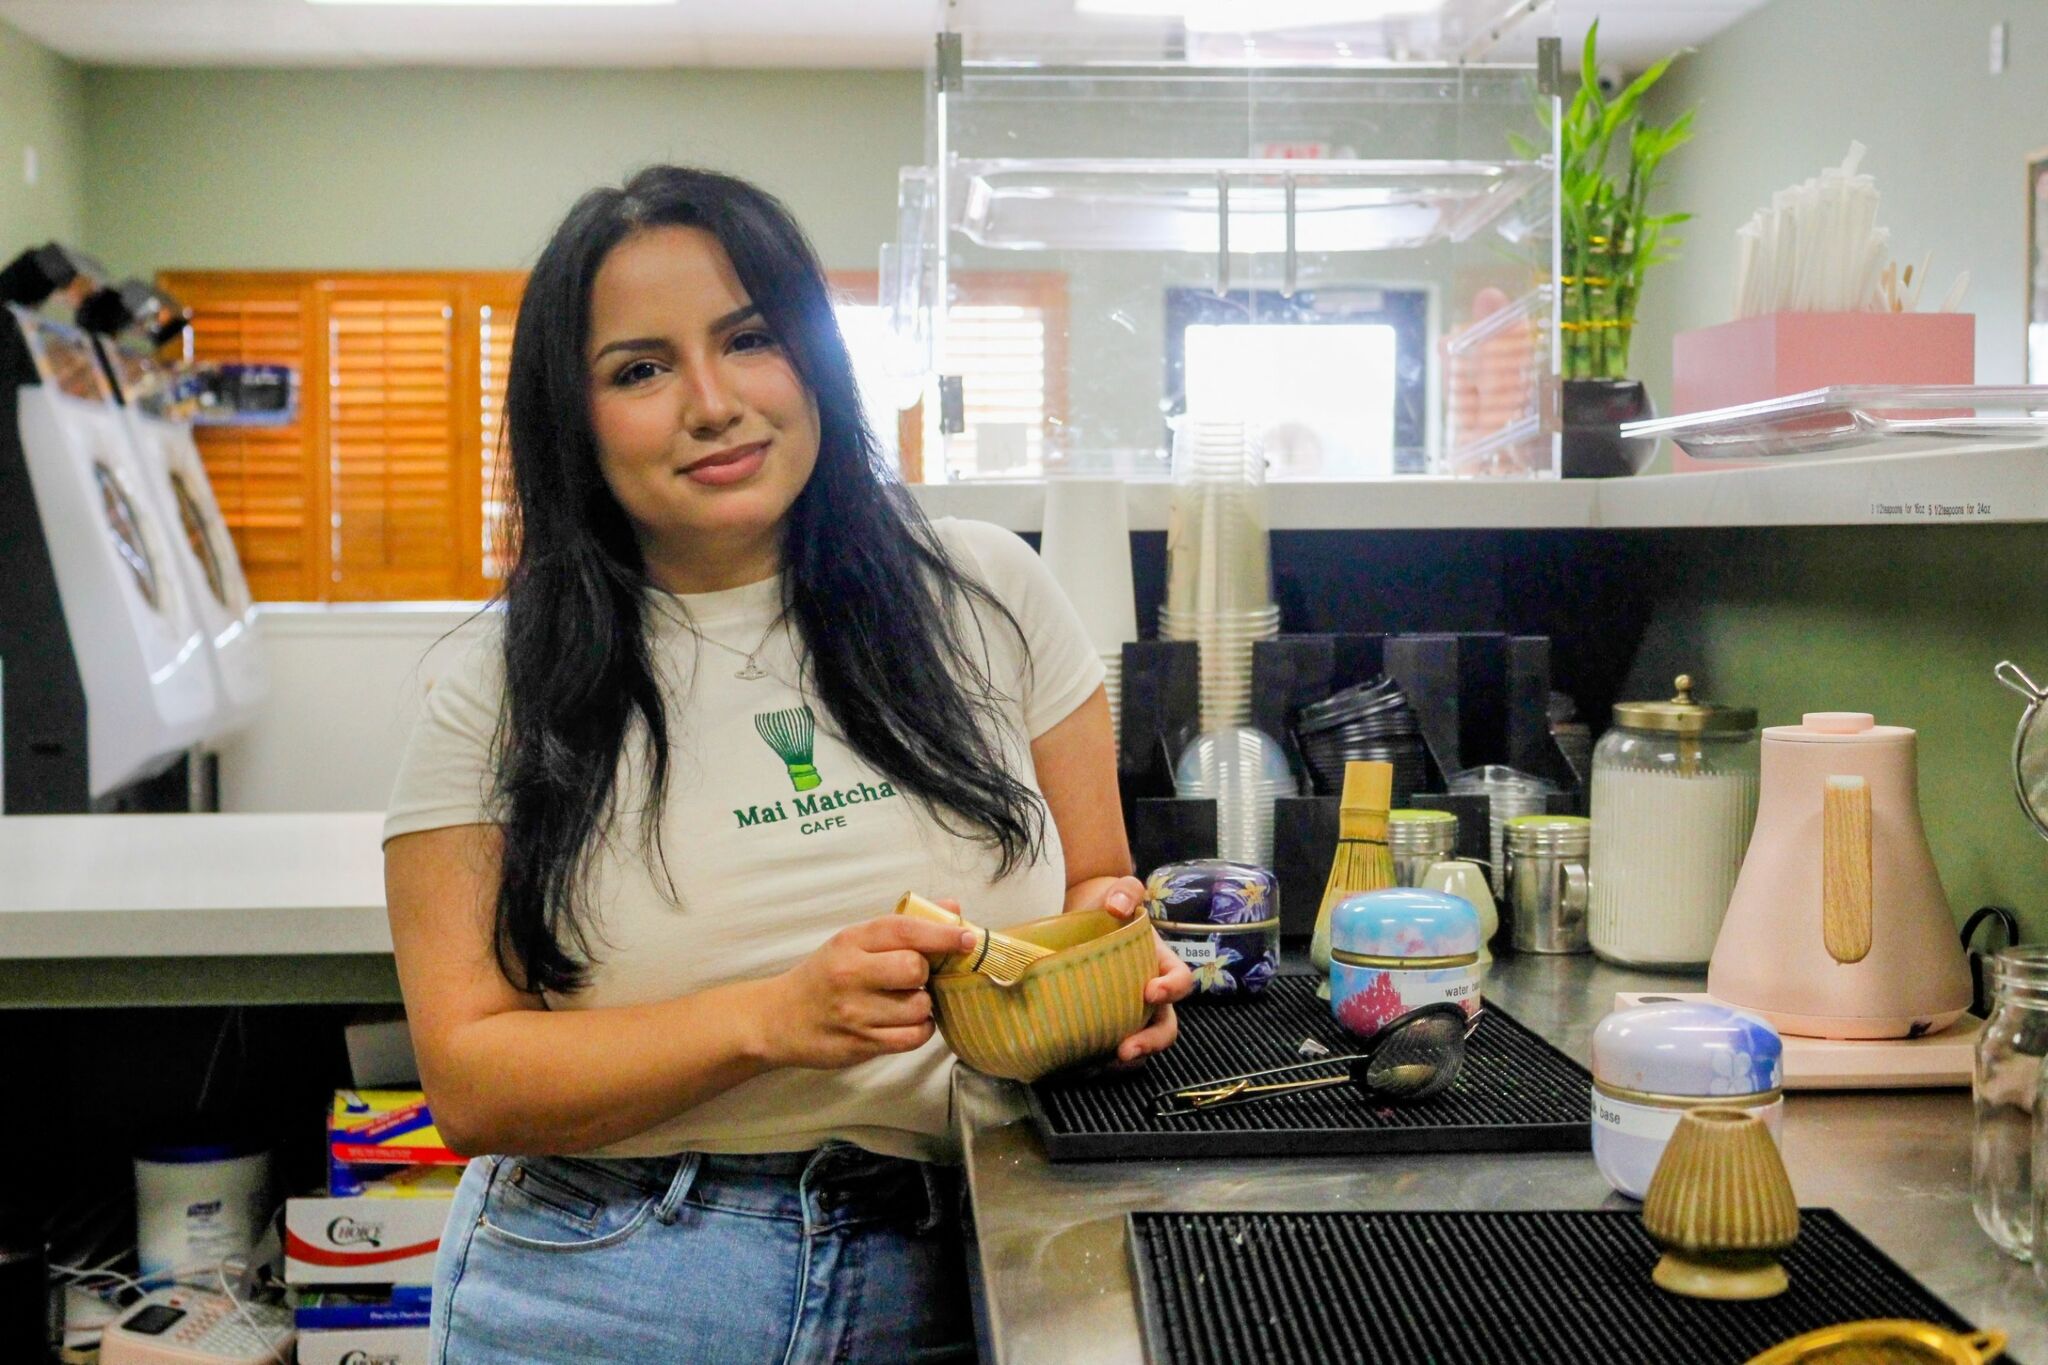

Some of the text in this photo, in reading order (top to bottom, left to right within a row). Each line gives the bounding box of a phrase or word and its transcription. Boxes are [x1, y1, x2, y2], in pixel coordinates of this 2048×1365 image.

[1967, 503, 1975, 515] for
[1977, 502, 1991, 515] 24oz
[733, 781, 897, 829] Mai Matcha
[800, 815, 847, 836] CAFE
[1185, 946, 1211, 958] base
[1445, 984, 1469, 998] water
[1599, 1103, 1621, 1125] base
